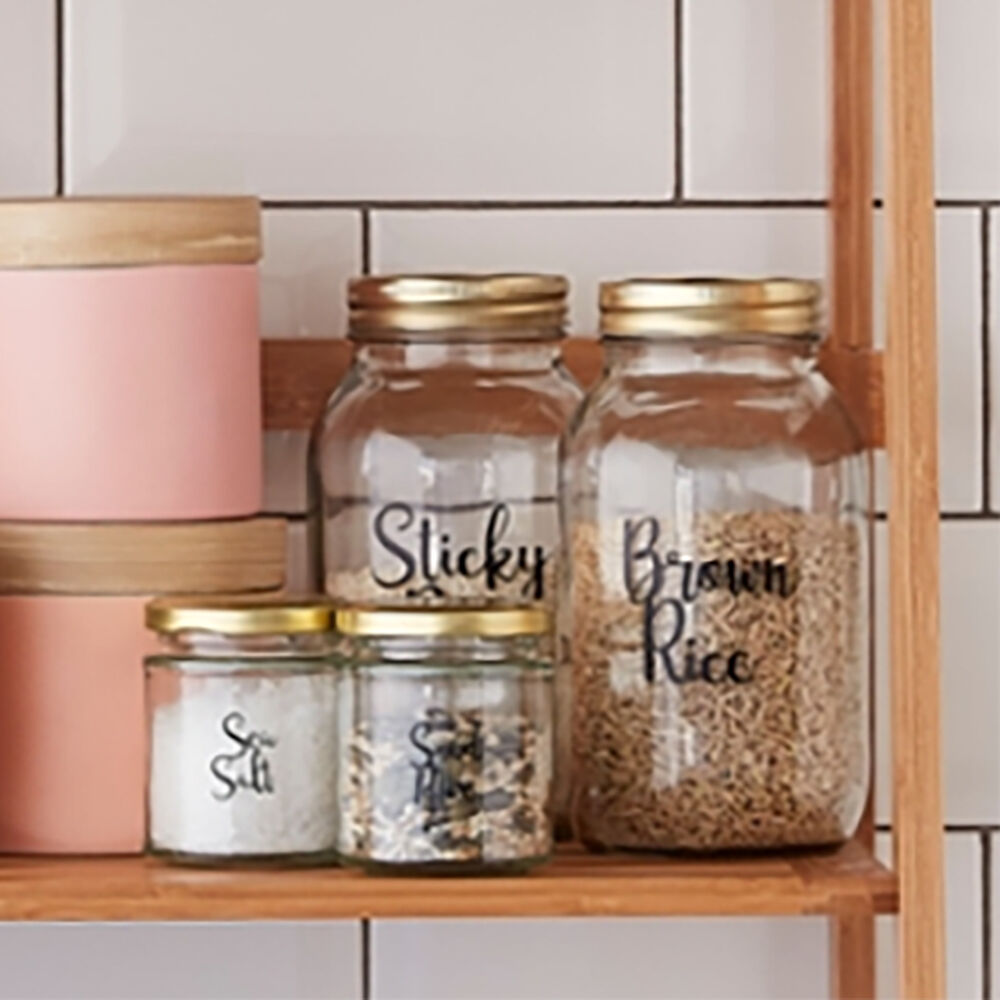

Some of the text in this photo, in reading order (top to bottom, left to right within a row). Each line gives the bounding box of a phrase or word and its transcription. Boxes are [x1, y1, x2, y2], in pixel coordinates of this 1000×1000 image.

[372, 501, 552, 600] Sticky
[623, 516, 800, 604] Brown
[643, 597, 762, 683] Rice
[209, 752, 275, 802] Salt
